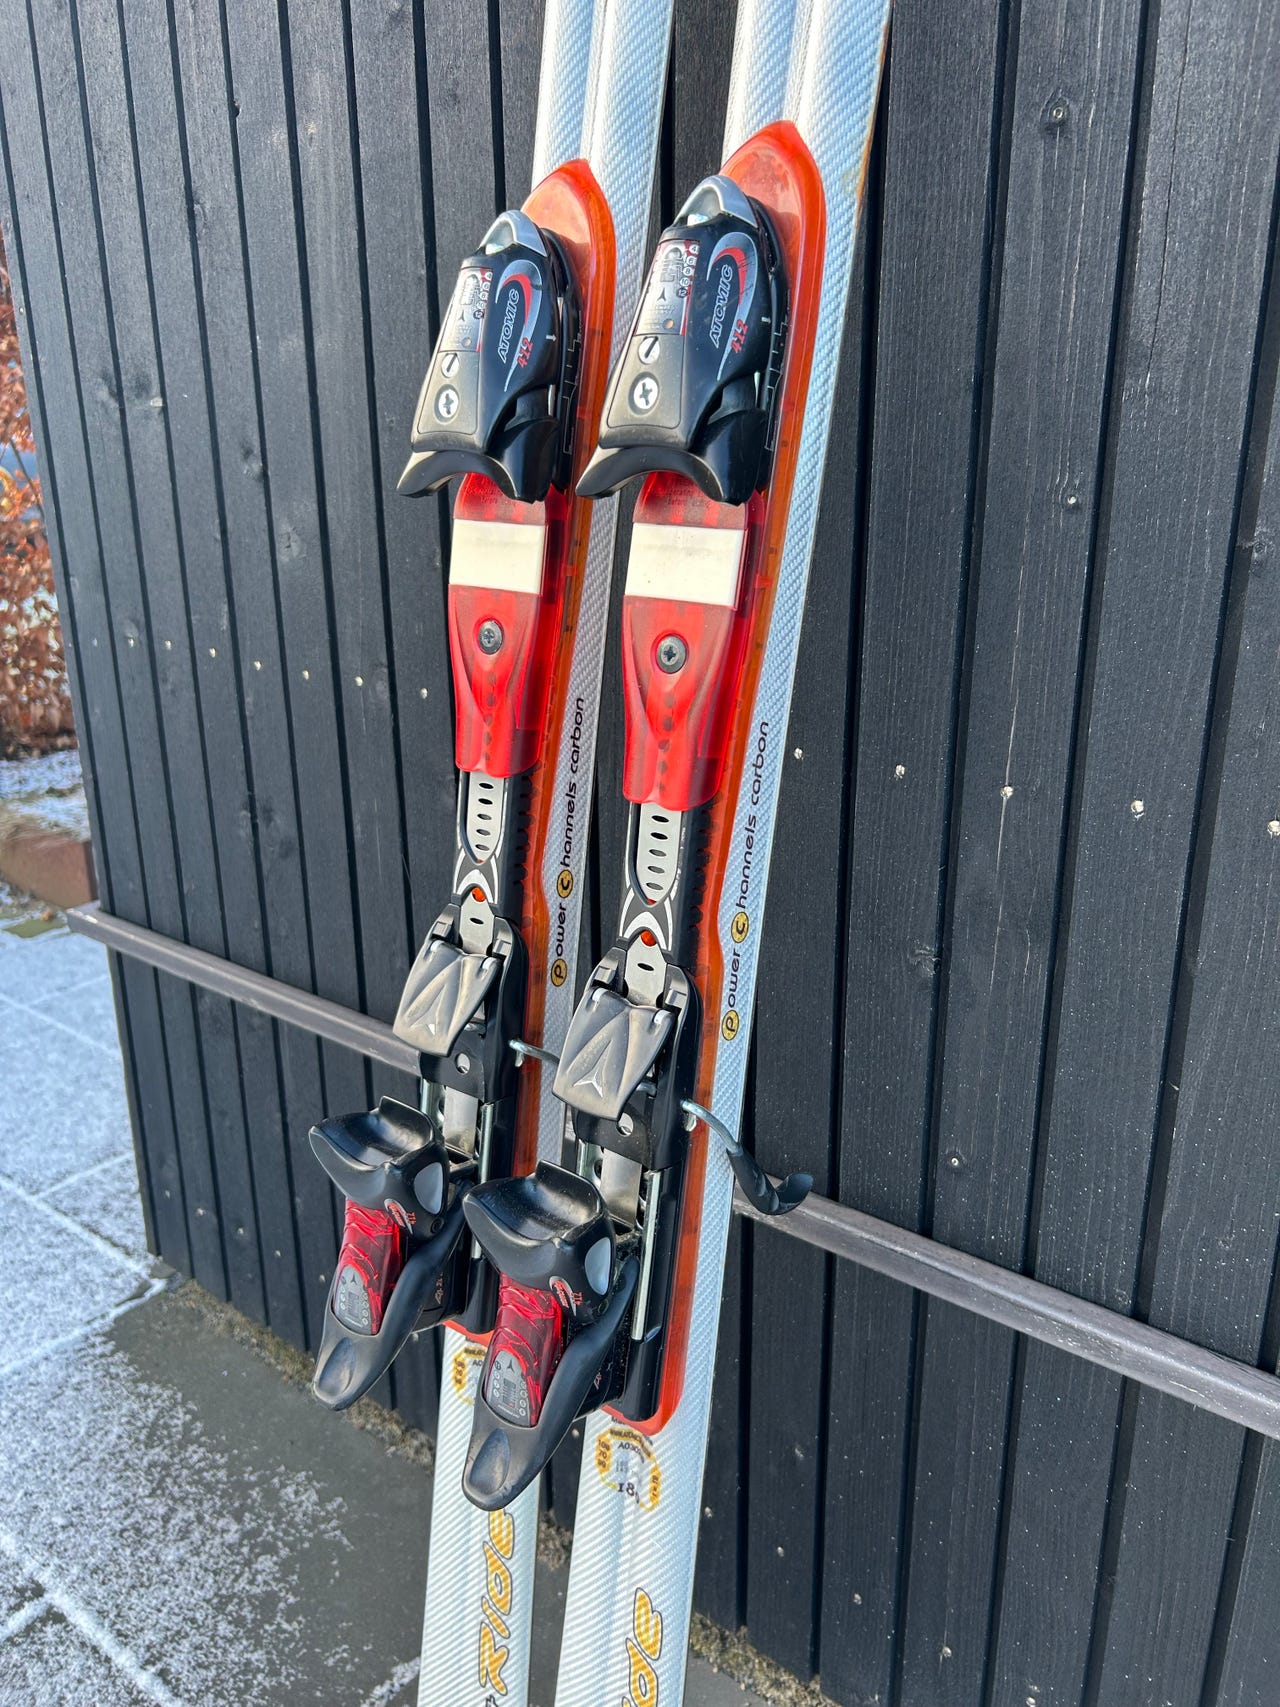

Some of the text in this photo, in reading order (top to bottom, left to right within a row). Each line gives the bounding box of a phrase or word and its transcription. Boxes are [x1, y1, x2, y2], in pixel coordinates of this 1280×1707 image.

[498, 289, 519, 364] ATOMIC
[709, 264, 733, 349] ATOMIC
[731, 318, 748, 353] 412
[517, 337, 533, 368] 412
[570, 697, 584, 774] carbon
[752, 721, 769, 807] carbon
[622, 1587, 663, 1707] DE
